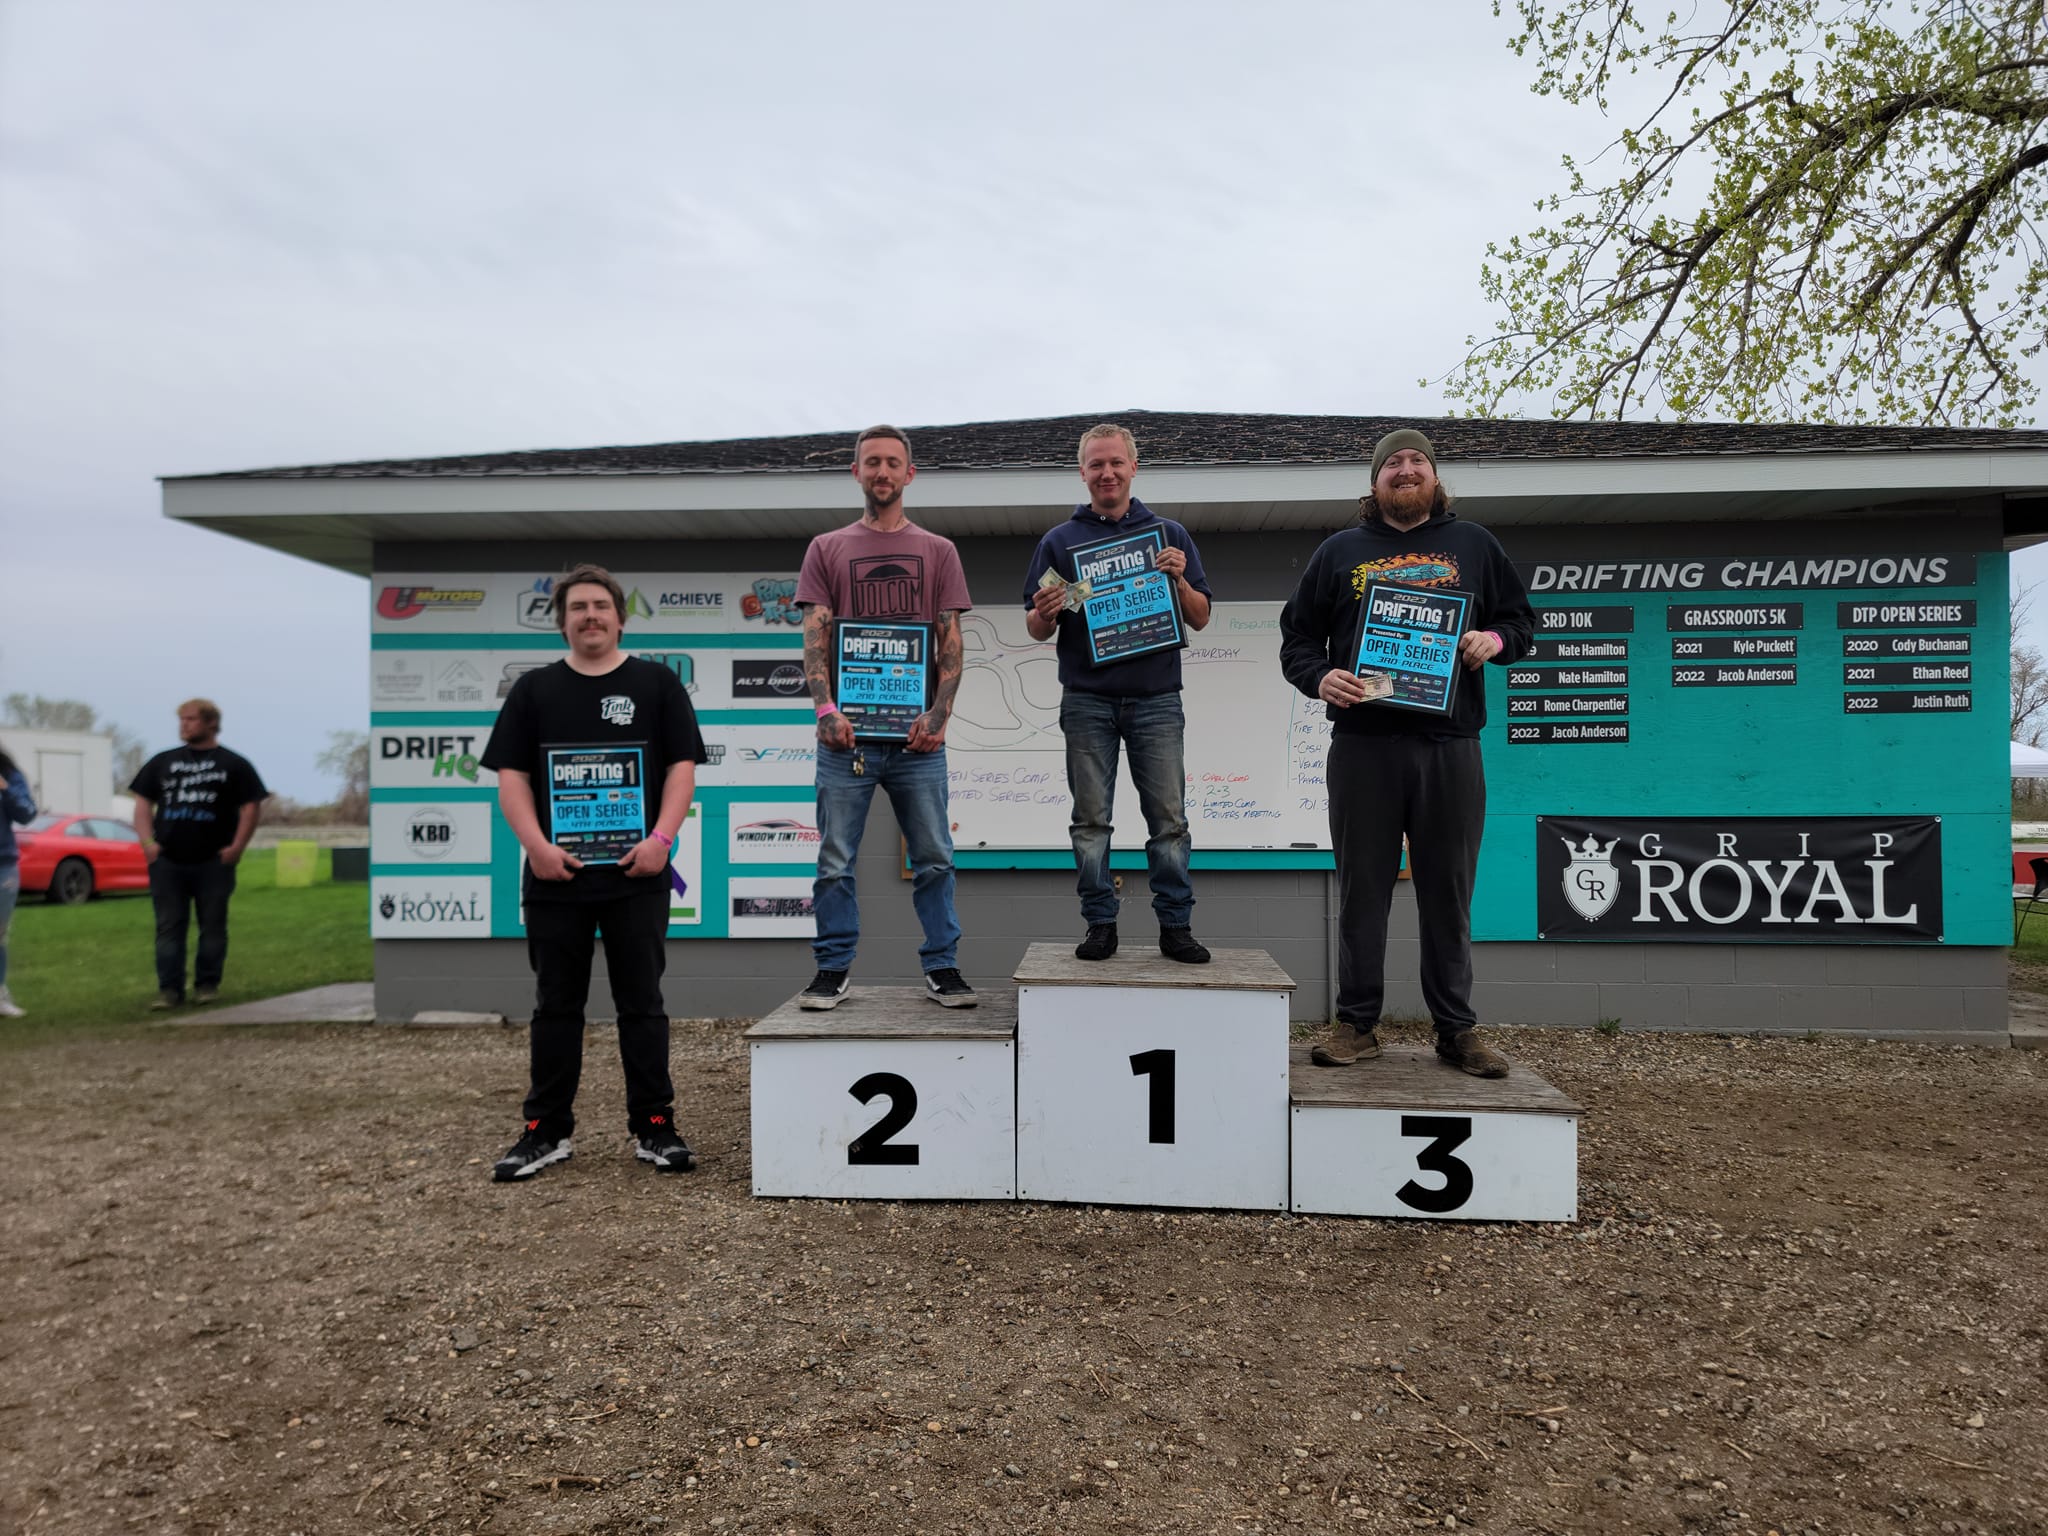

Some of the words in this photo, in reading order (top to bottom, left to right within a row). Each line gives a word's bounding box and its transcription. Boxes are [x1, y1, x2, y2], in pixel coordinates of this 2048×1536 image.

[1095, 545, 1126, 559] 2023
[1081, 550, 1145, 580] DRIFTING
[1145, 544, 1157, 568] 1
[1530, 563, 1705, 590] DRIFTING
[1721, 557, 1948, 588] CHAMPIONS
[660, 593, 723, 605] ACHIEVE
[1090, 598, 1120, 617] OPEN
[1124, 585, 1165, 607] SERIES
[1392, 593, 1428, 604] 2023
[1105, 613, 1120, 622] 1ST
[1125, 605, 1154, 617] PLACE
[1372, 600, 1443, 624] DRIFTING
[1446, 608, 1456, 632] 1
[1542, 612, 1567, 628] SRD
[1570, 612, 1593, 628] 10K
[1684, 609, 1767, 626] GRASSROOTS
[1769, 608, 1786, 625] 5K
[1853, 607, 1877, 623] DTP
[1880, 606, 1916, 622] OPEN
[1918, 605, 1962, 622] SERIES
[1381, 615, 1401, 625] THE
[1402, 619, 1440, 630] PLAINS
[844, 637, 908, 655] DRIFTING
[910, 638, 919, 661] 1
[1366, 638, 1400, 656] OPEN
[1404, 644, 1450, 664] SERIES
[1558, 644, 1580, 656] Nate
[1582, 643, 1625, 656] Hamilton
[1675, 643, 1703, 654] 2021
[1733, 640, 1754, 655] Kyle
[1756, 640, 1794, 653] Puckett
[1847, 641, 1878, 651] 2020
[1892, 639, 1917, 653] Cody
[1918, 638, 1968, 651] Buchanan
[1377, 655, 1398, 665] 3RD
[1401, 660, 1435, 671] PLACE
[1510, 673, 1540, 684] 2020
[1558, 671, 1580, 684] Nate
[1582, 671, 1625, 684] Hamilton
[1675, 671, 1705, 682] 2022
[1717, 669, 1745, 682] Jacob
[1747, 668, 1794, 681] Anderson
[1847, 668, 1875, 680] 2021
[1912, 666, 1941, 679] Ethan
[1943, 666, 1969, 679] Reed
[736, 677, 764, 686] AL'S
[843, 677, 874, 691] OPEN
[880, 679, 920, 692] SERIES
[1511, 700, 1537, 712] 2021
[1544, 699, 1570, 712] Rome
[1572, 698, 1626, 713] Charpentier
[1847, 698, 1878, 709] 2022
[1912, 695, 1943, 709] Justin
[1944, 694, 1969, 708] Ruth
[1293, 720, 1313, 733] TIRE
[1511, 728, 1540, 739] 2022
[1551, 726, 1579, 739] Jacob
[1580, 725, 1626, 738] Anderson
[381, 737, 475, 759] DRIFT
[432, 754, 479, 783] HQ
[554, 763, 623, 781] DRIFTING
[625, 760, 635, 784] 1
[557, 805, 590, 819] OPEN
[595, 803, 639, 818] SERIES
[412, 825, 450, 842] KBD
[737, 832, 776, 841] WINDOW
[1639, 832, 1894, 858] GRIP
[1631, 858, 1918, 925] ROYAL
[400, 900, 484, 922] ROYAL
[1130, 1049, 1176, 1145] 1
[847, 1072, 920, 1165] 2
[1395, 1115, 1474, 1213] 3
